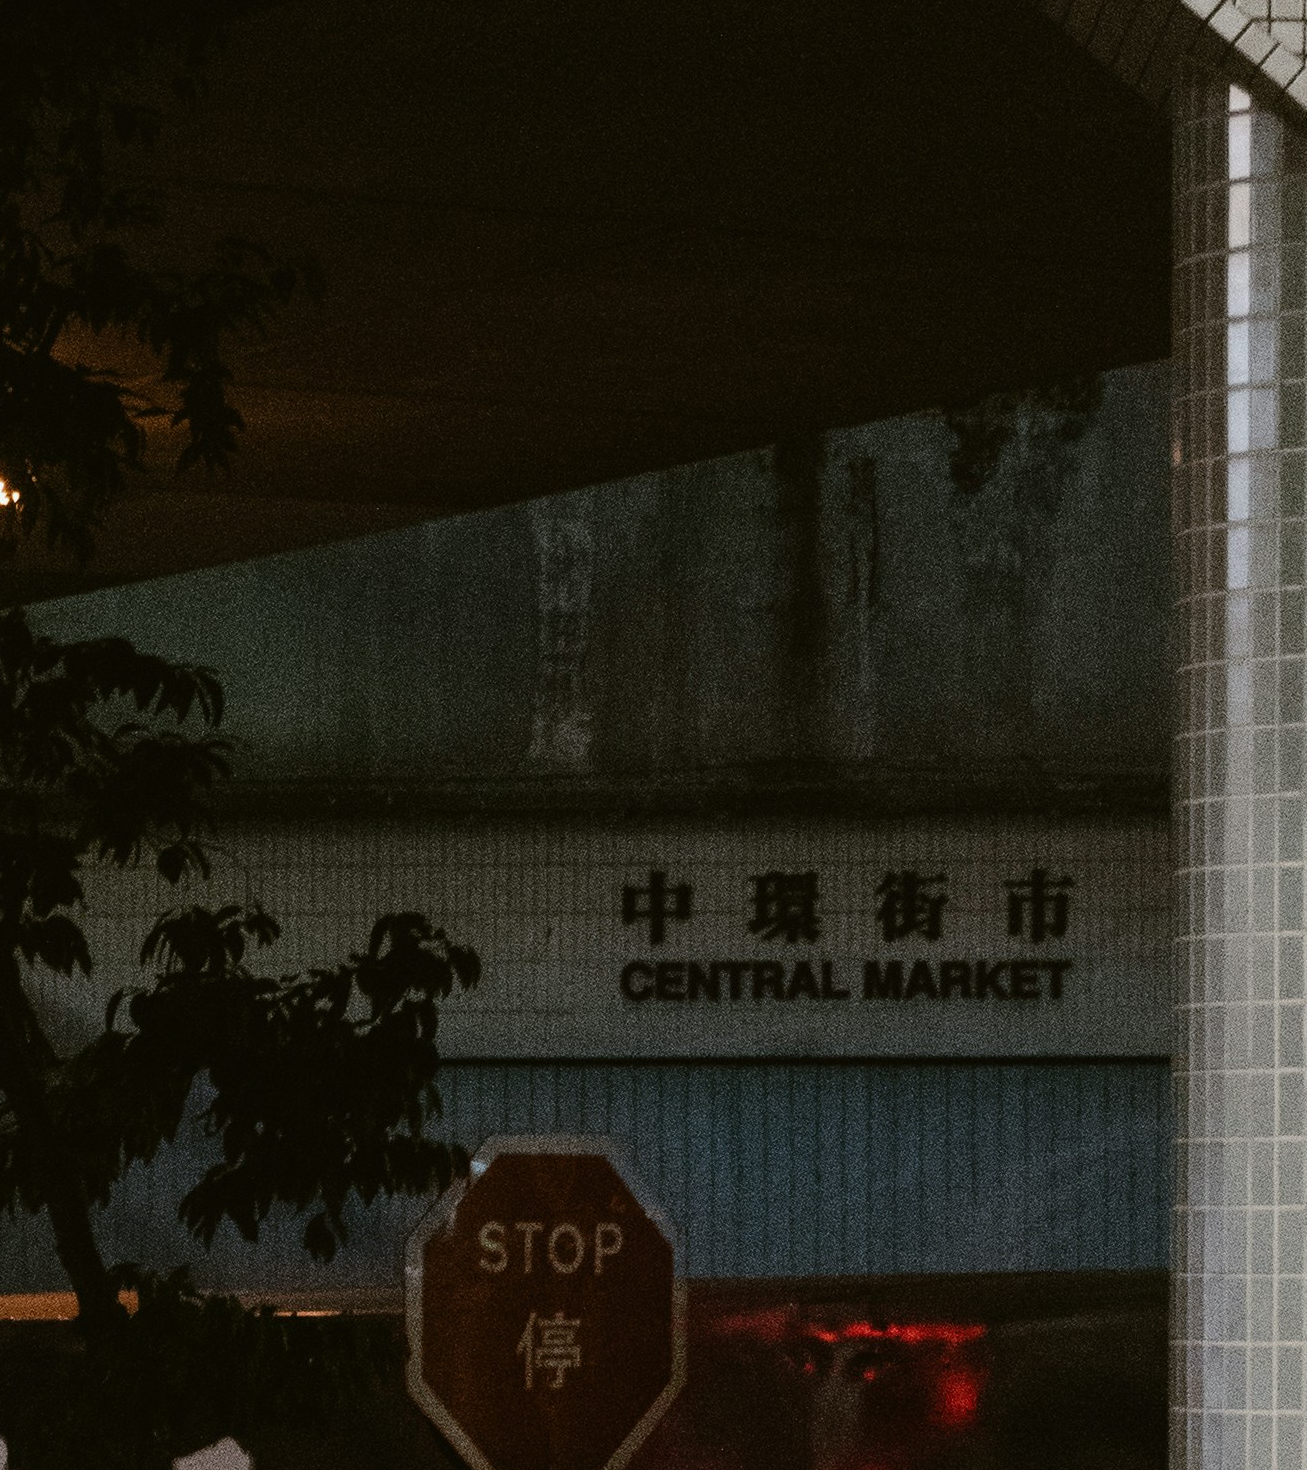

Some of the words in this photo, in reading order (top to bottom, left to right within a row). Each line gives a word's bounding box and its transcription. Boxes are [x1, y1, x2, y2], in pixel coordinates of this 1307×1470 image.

[620, 868, 1076, 944] 中環街市
[619, 960, 851, 1002] CENTRAL
[862, 959, 1074, 1001] MARKET
[478, 1220, 624, 1276] STOP
[516, 1310, 582, 1390] 停
